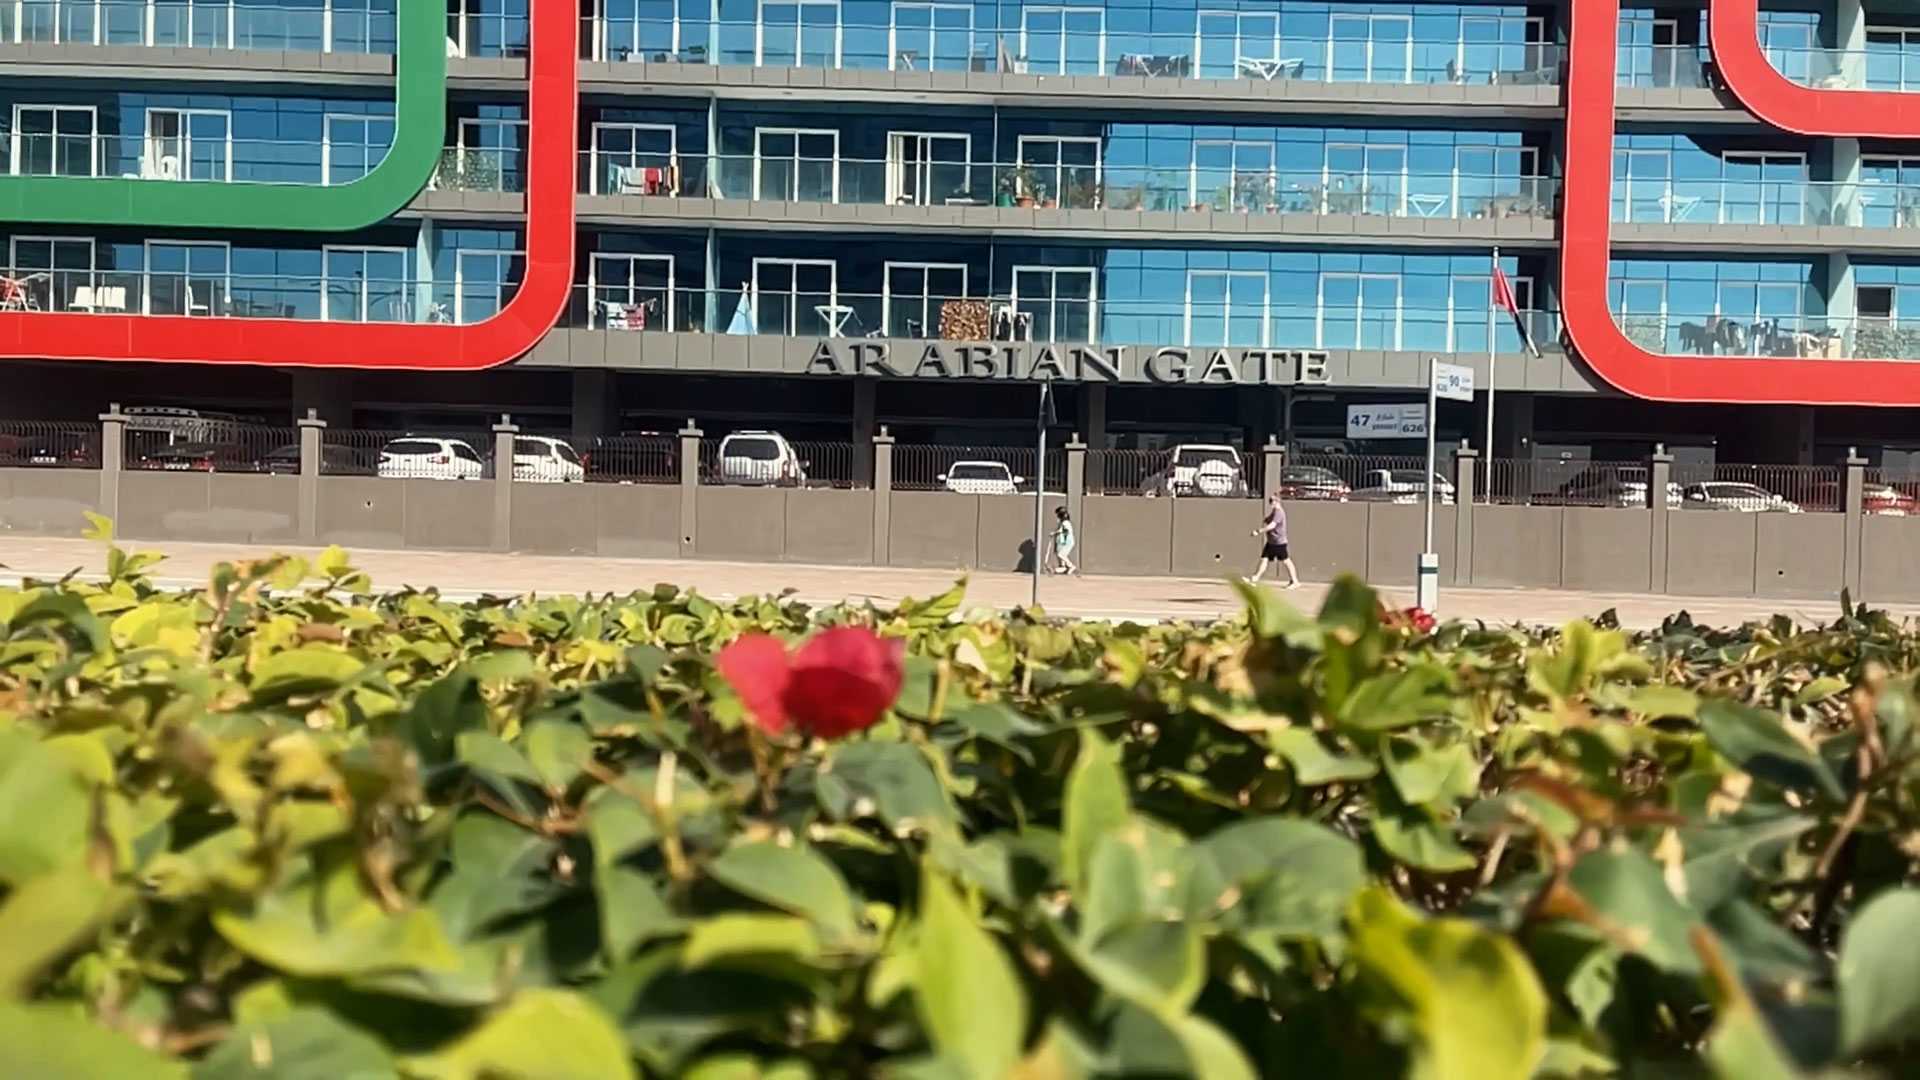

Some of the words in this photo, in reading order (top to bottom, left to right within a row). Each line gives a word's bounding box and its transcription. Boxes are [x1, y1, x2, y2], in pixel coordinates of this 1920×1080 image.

[806, 341, 1127, 382] ARABIAN
[1144, 346, 1332, 386] GATE
[1350, 414, 1371, 426] 47
[1402, 424, 1424, 433] 626
